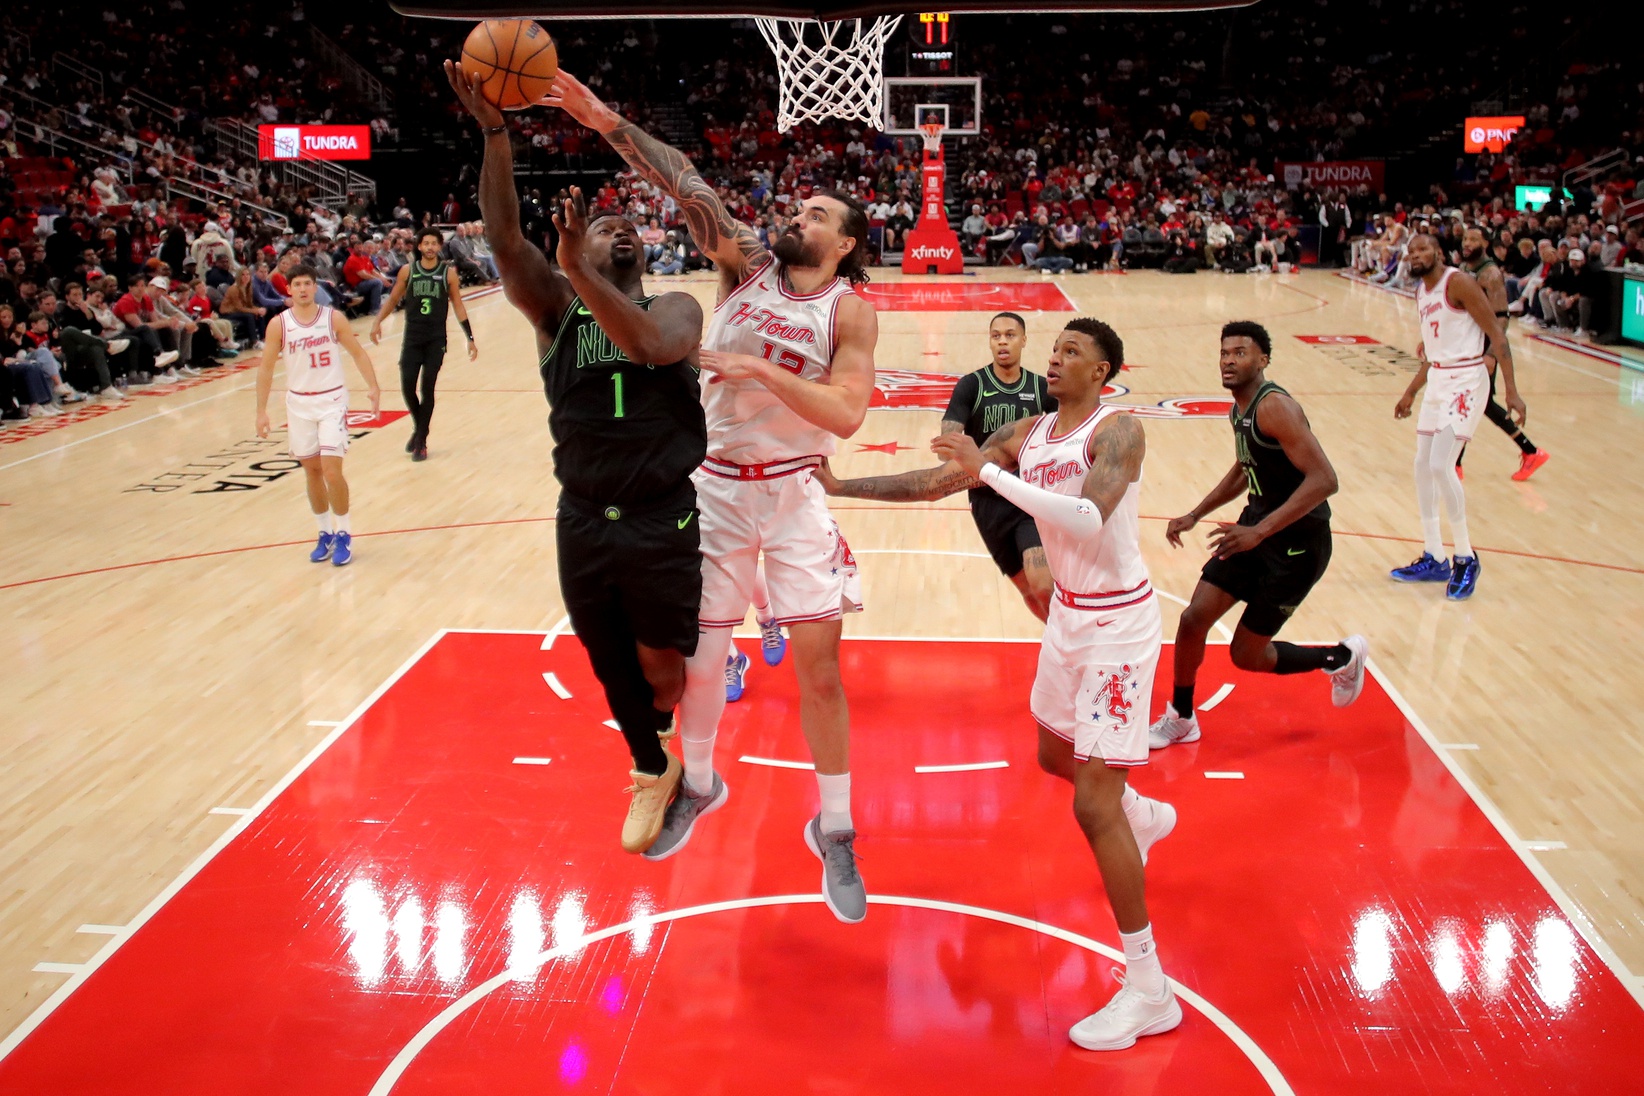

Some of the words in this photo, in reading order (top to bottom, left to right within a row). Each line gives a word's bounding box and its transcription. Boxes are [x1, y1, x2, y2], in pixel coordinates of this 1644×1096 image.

[926, 22, 948, 45] 11
[303, 135, 358, 150] TUNDRA
[1306, 165, 1373, 181] TUNDRA
[911, 244, 954, 260] xfinity
[413, 279, 440, 299] NOLA
[420, 297, 432, 315] 3
[726, 301, 817, 344] H-Town
[1430, 320, 1440, 338] 7
[288, 335, 331, 355] H-Town
[309, 350, 332, 369] 15
[610, 372, 625, 418] 1
